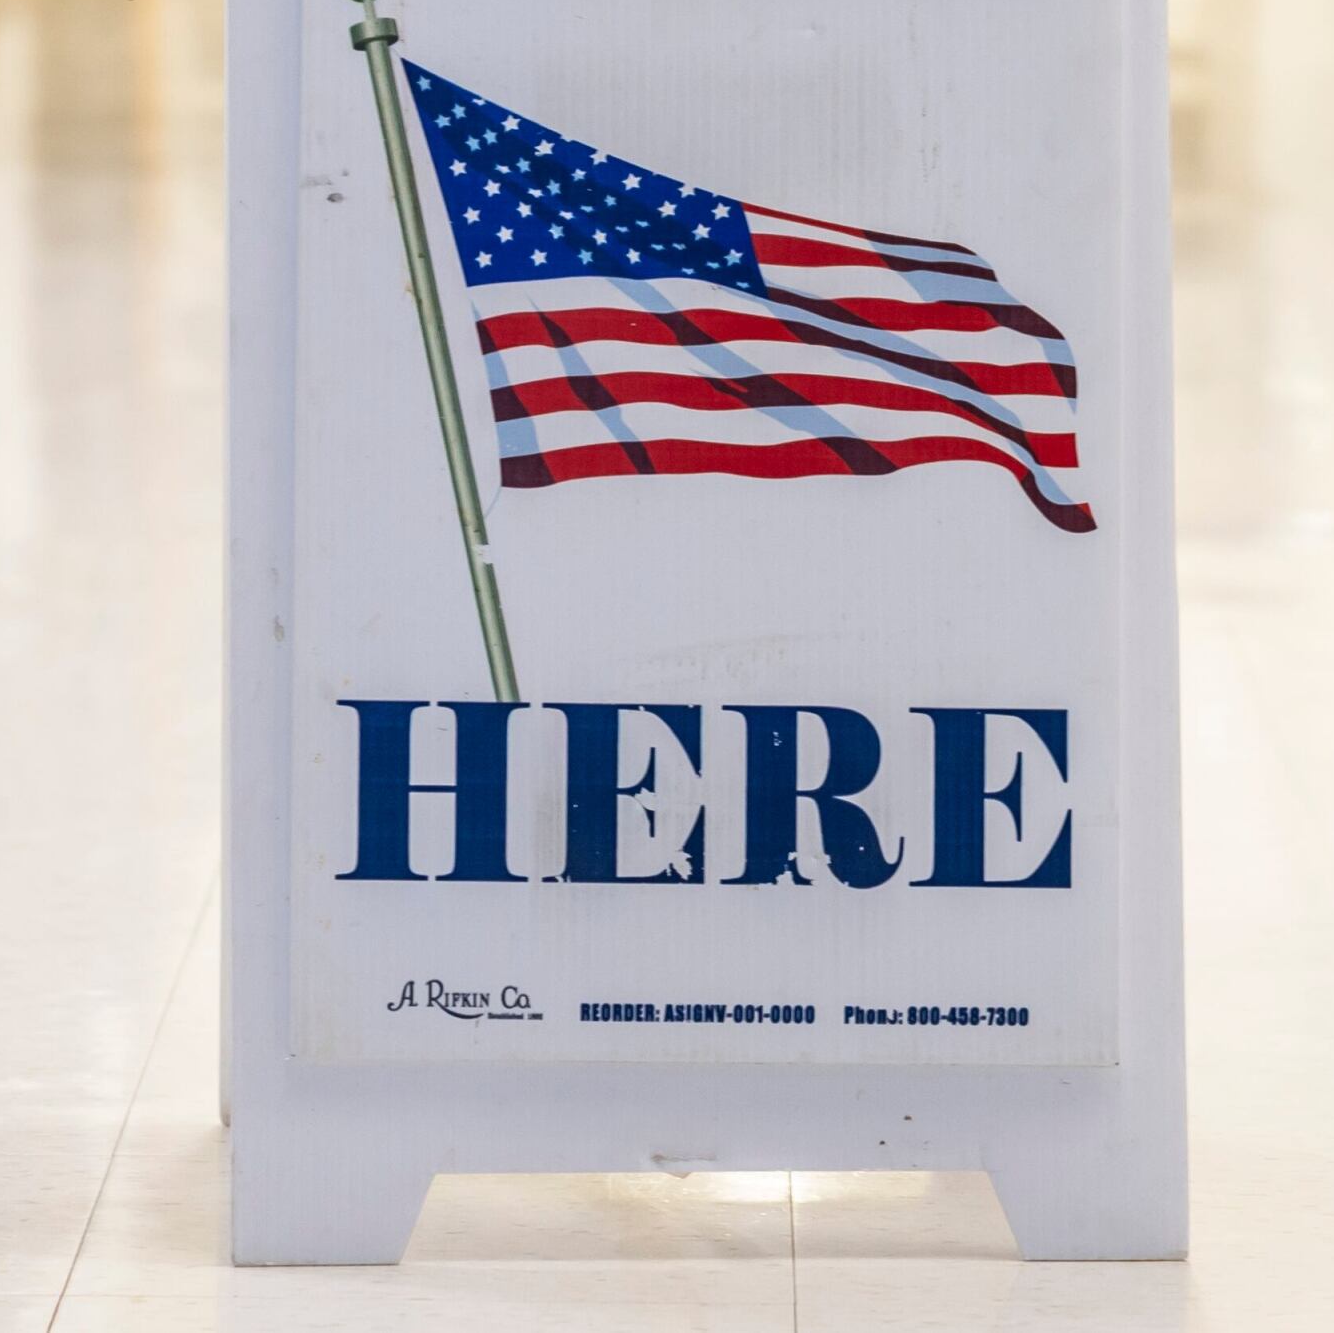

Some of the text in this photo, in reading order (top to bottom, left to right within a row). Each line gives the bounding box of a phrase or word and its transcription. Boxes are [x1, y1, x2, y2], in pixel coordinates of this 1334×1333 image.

[334, 699, 1074, 890] HERE
[425, 979, 490, 1020] RIFKIN
[580, 1002, 661, 1023] REORDER:
[907, 1005, 1030, 1027] 800-458-7300
